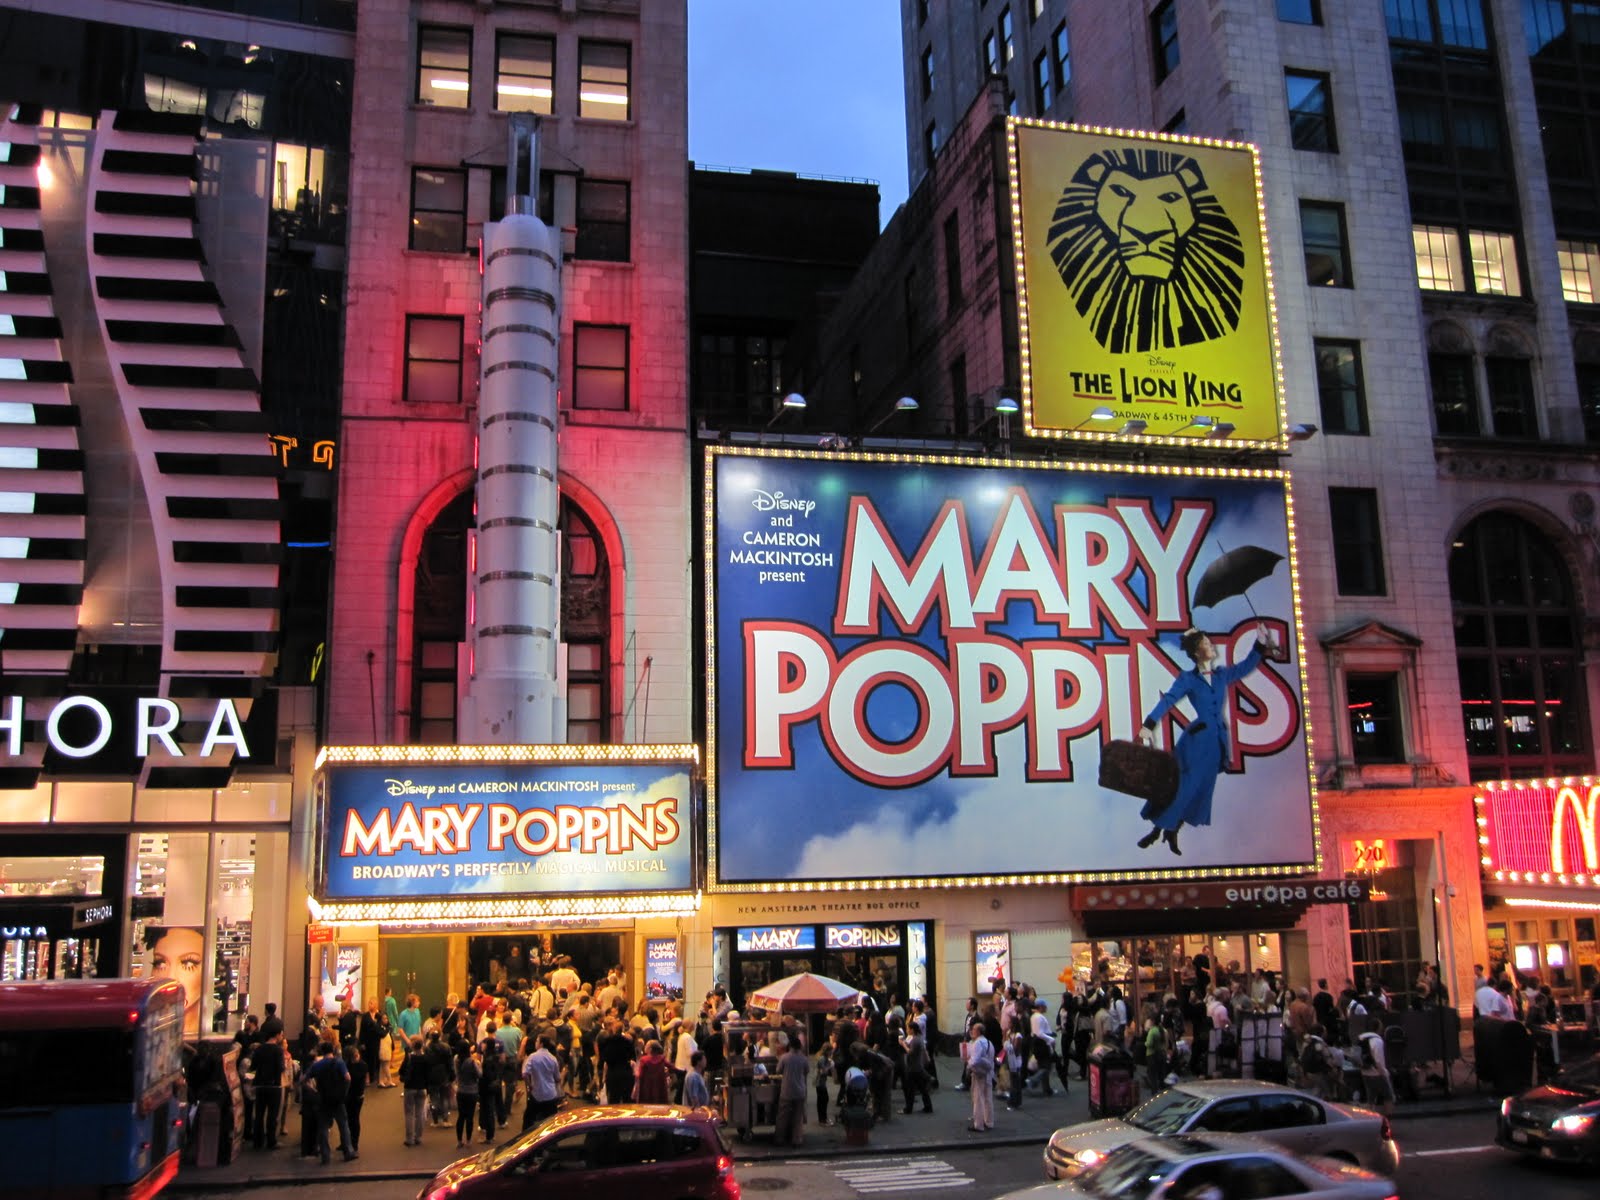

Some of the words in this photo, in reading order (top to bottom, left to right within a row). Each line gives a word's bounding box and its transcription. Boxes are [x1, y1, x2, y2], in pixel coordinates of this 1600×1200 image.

[1070, 372, 1112, 394] THE
[1120, 368, 1177, 403] LION
[1183, 372, 1242, 407] KING
[1112, 410, 1151, 420] OADWAY
[1162, 414, 1187, 422] 45TH
[1190, 415, 1220, 424] SET
[752, 488, 815, 518] Disney
[770, 514, 793, 527] and
[743, 531, 820, 547] CAMERON
[729, 550, 833, 567] MACKINTOSH
[833, 486, 1214, 637] MARY
[759, 571, 806, 584] present
[742, 617, 1300, 787] POPPINS
[384, 778, 436, 799] Disney
[438, 783, 455, 793] and
[458, 782, 517, 794] CAMERON
[520, 780, 599, 793] MACKINTOSH
[602, 782, 636, 793] present
[339, 801, 483, 857] MARY
[487, 798, 680, 856] POPPINS
[1355, 846, 1382, 861] 220
[352, 863, 450, 880] BROADWAY'S
[454, 862, 531, 877] PERFECTLY
[535, 860, 601, 875] MAGICAL
[605, 858, 667, 873] MUSICAL
[1226, 884, 1307, 904] europa
[1313, 880, 1361, 899] café
[85, 905, 113, 922] SEPHORA
[738, 906, 757, 914] NEW
[761, 904, 817, 913] AMSTERDAM
[822, 903, 862, 911] THEATRE
[867, 902, 884, 910] BOX
[888, 901, 921, 910] OFFICE
[751, 928, 801, 950] MARY
[828, 925, 900, 948] POPPINS
[982, 936, 1003, 945] MARY
[337, 949, 356, 959] ARY
[649, 950, 677, 960] POPPIN
[654, 942, 676, 951] MARY
[977, 943, 1008, 952] POPPINS
[914, 934, 922, 991] TICK
